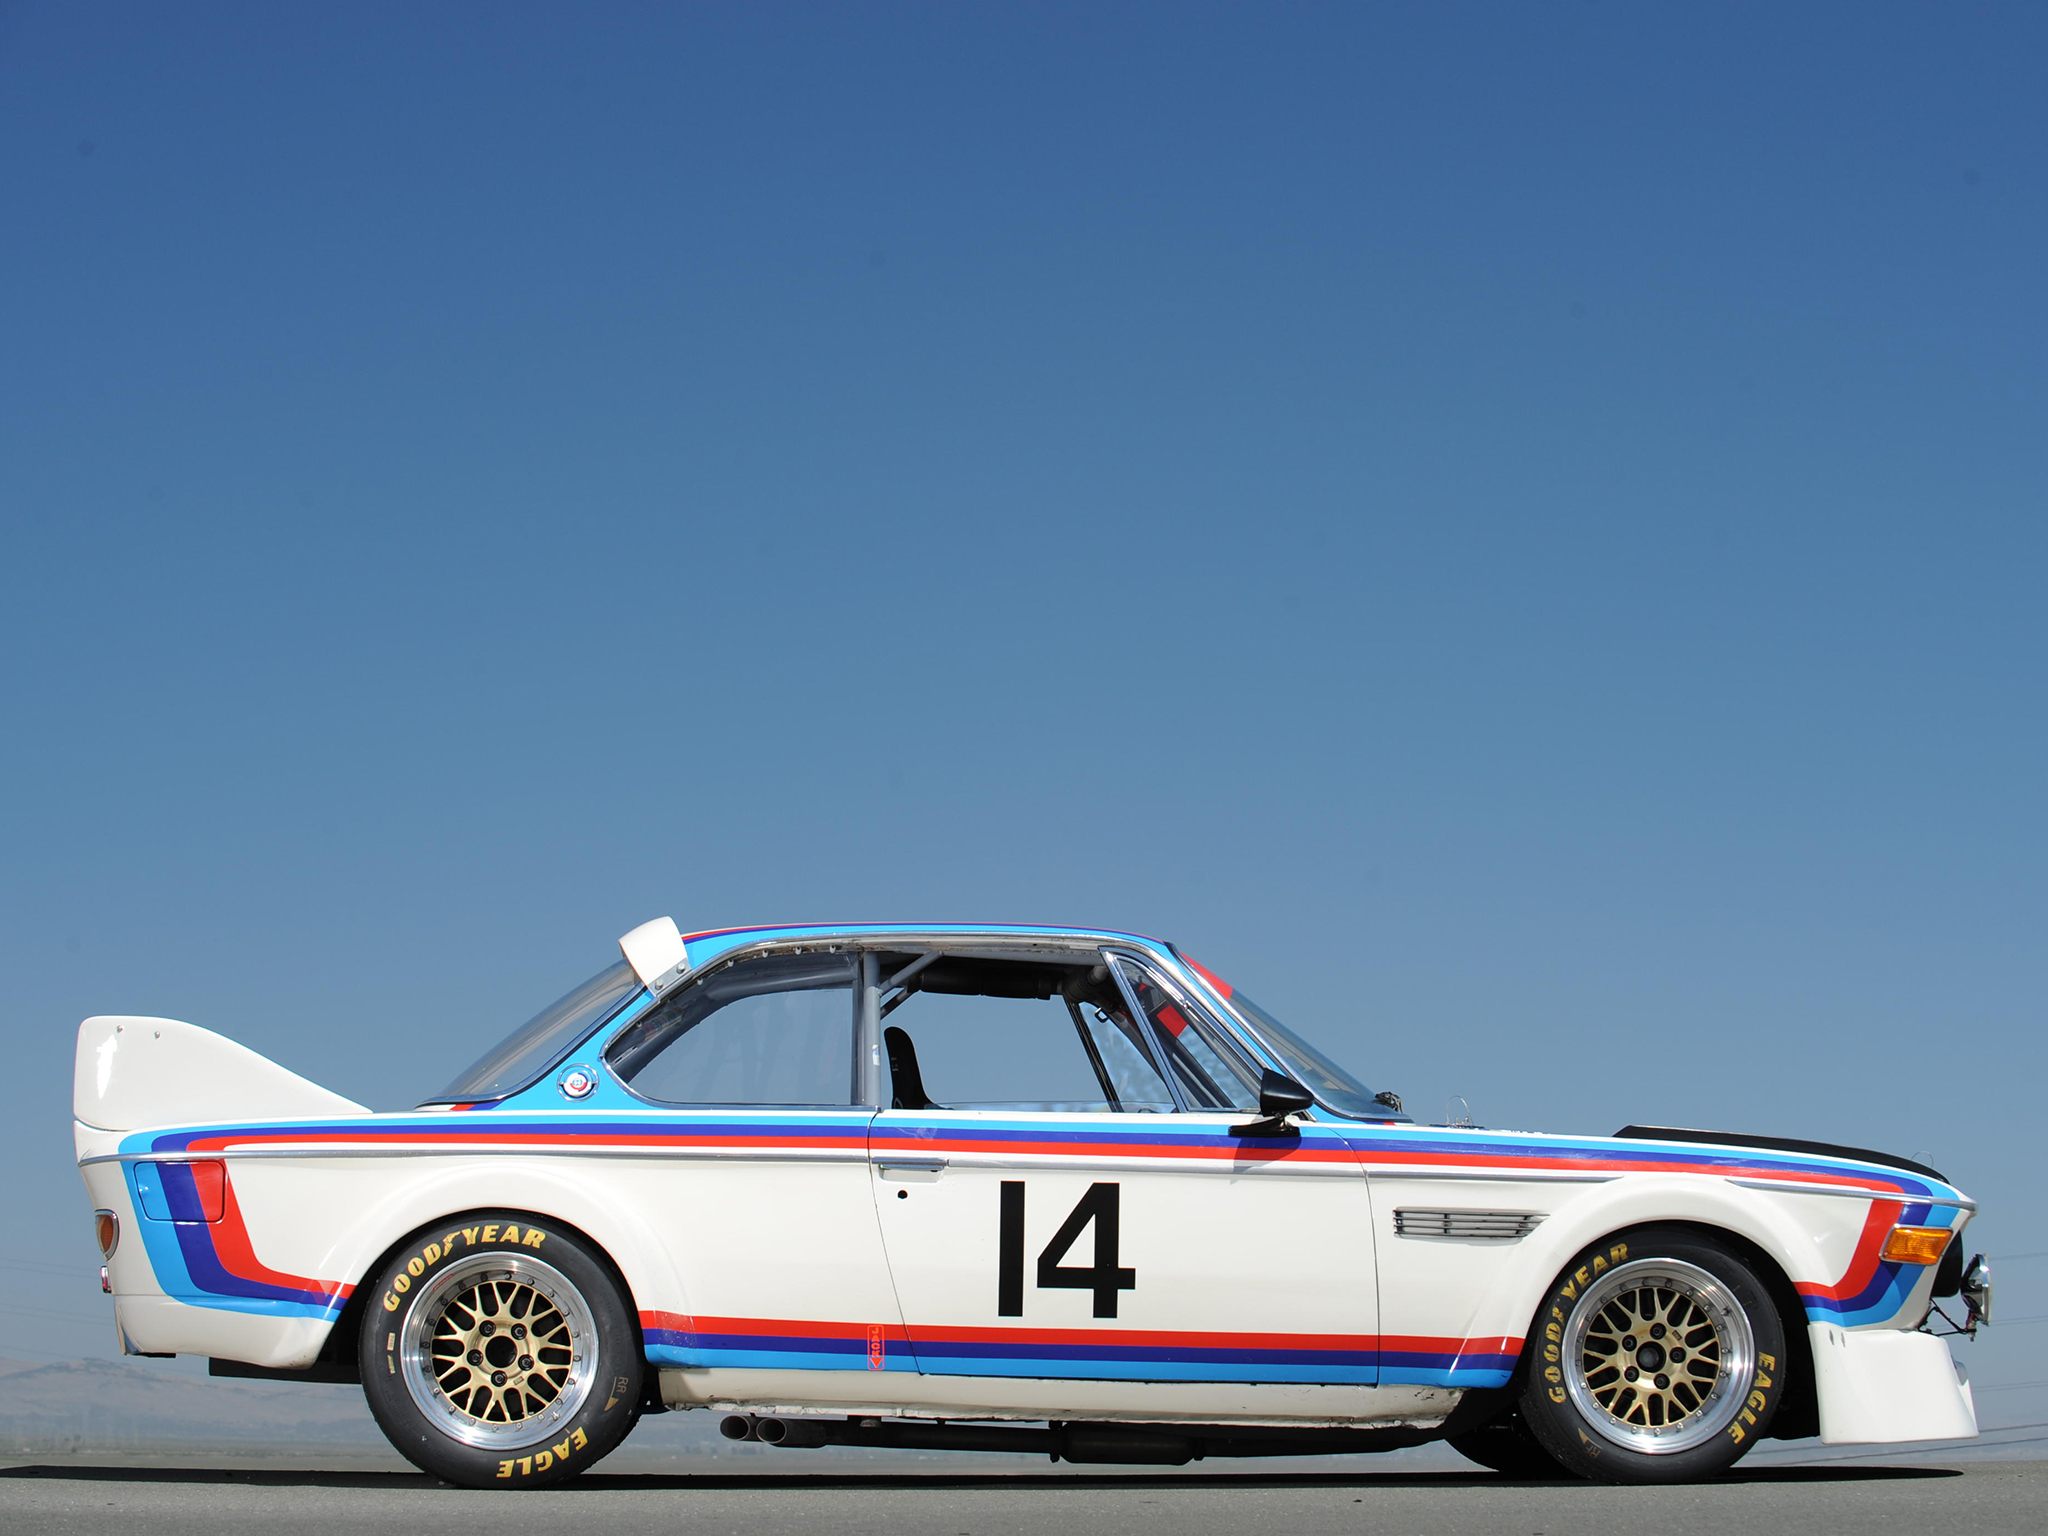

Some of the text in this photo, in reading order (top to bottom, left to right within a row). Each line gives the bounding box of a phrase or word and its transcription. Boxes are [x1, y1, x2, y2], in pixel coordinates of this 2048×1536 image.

[383, 1224, 546, 1312] GOODYEAR
[999, 1180, 1136, 1319] 14
[871, 1327, 881, 1357] JACK
[1543, 1243, 1629, 1403] GOODYEAR
[617, 1376, 628, 1393] RR
[1727, 1351, 1776, 1444] EAGLE
[496, 1426, 588, 1478] EAGLE
